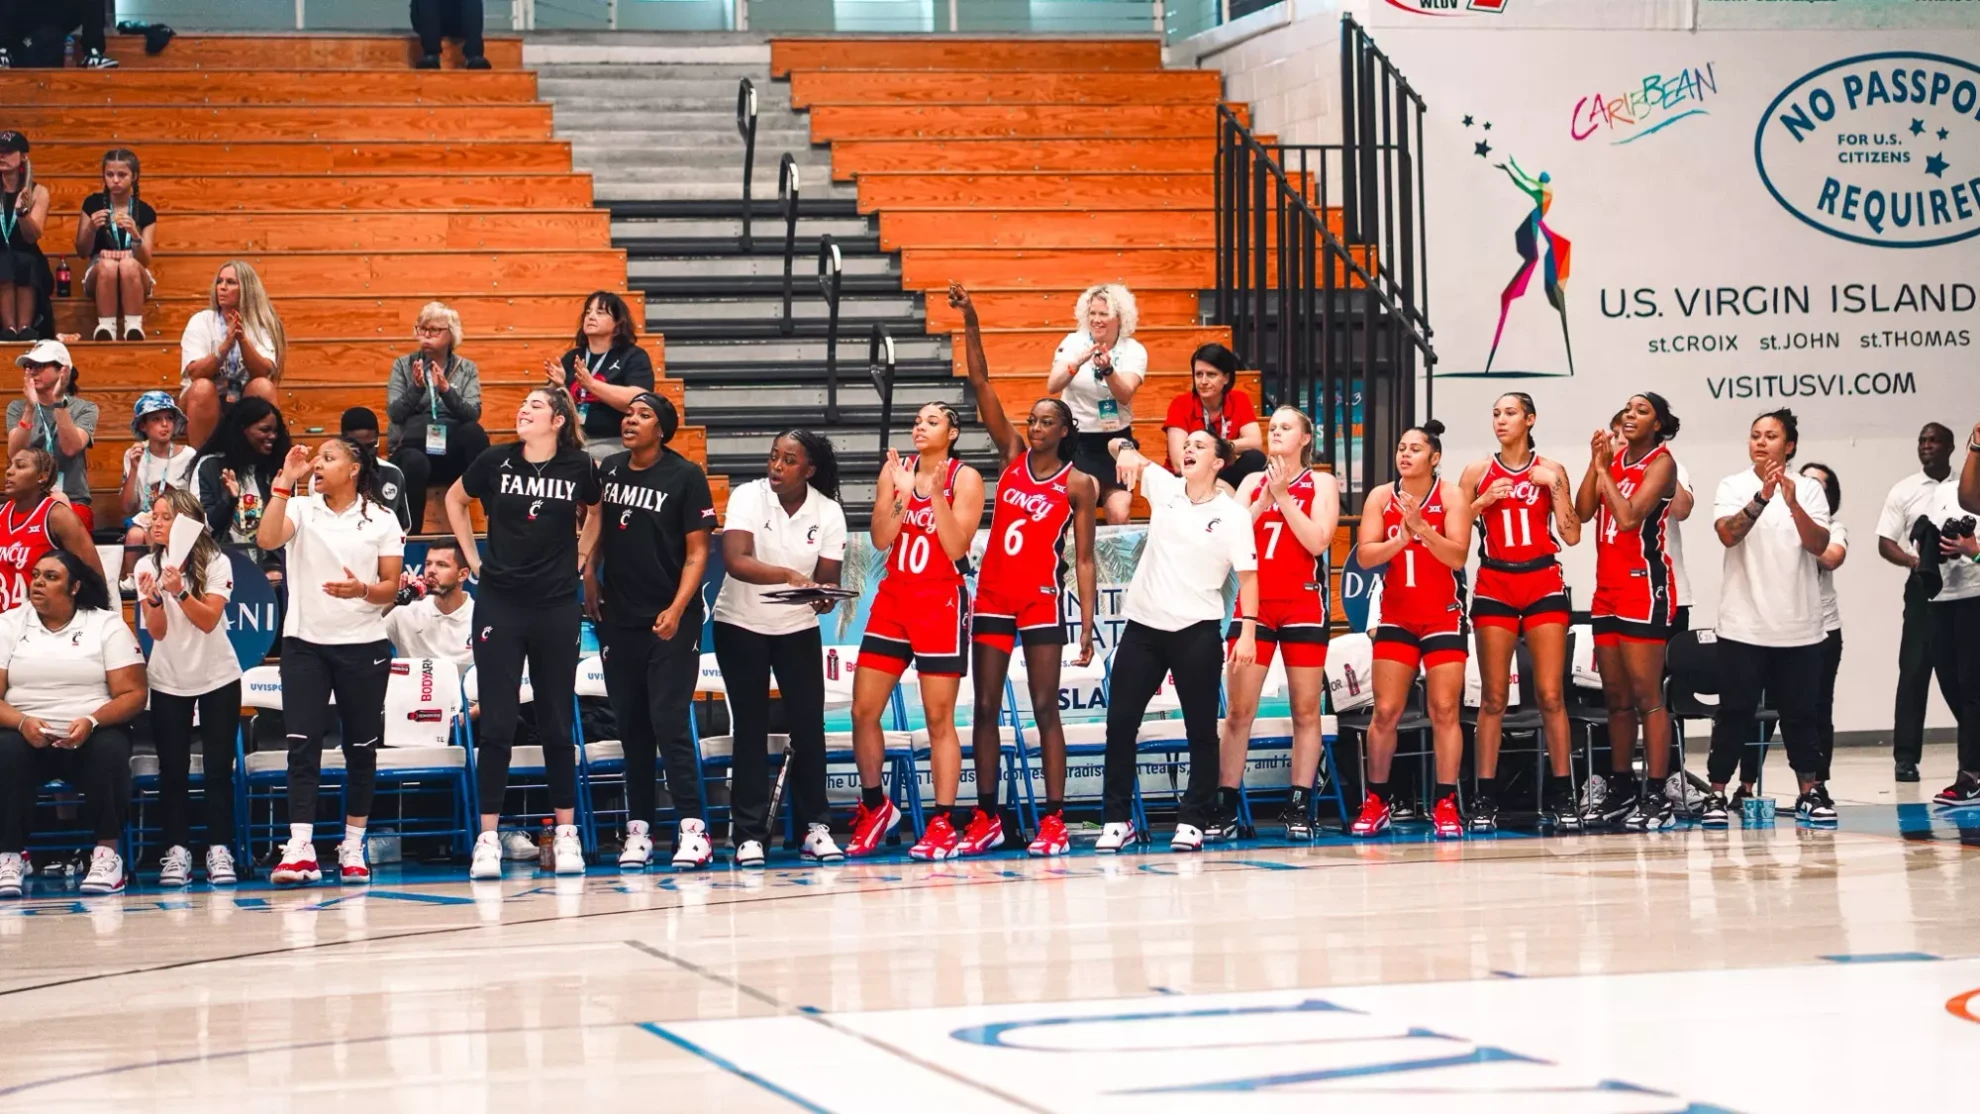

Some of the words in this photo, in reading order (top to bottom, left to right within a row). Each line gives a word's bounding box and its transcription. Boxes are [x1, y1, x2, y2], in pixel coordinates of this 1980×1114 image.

[1571, 61, 1717, 141] CARIBBEAN
[1779, 88, 1836, 143] NO
[1842, 68, 1980, 122] PASSPO
[1838, 133, 1869, 146] FOR
[1873, 133, 1903, 146] U.S.
[1838, 151, 1911, 164] CITIZENS
[1600, 288, 1664, 319] U.S.
[1674, 284, 1810, 317] VIRGIN
[1831, 283, 1980, 314] ISLAND
[1648, 335, 1739, 353] st.CROIX
[1759, 332, 1841, 351] st.JOHN
[1860, 330, 1971, 349] st.THOMAS
[1707, 372, 1917, 399] VISITUSVI.COM
[500, 473, 577, 501] FAMILY
[603, 482, 669, 513] FAMILY
[1004, 518, 1027, 556] 6
[1263, 521, 1284, 560] 7
[1501, 508, 1533, 548] 11
[898, 531, 930, 574] 10
[1404, 549, 1417, 588] 1
[827, 774, 844, 789] he
[1254, 755, 1278, 769] and
